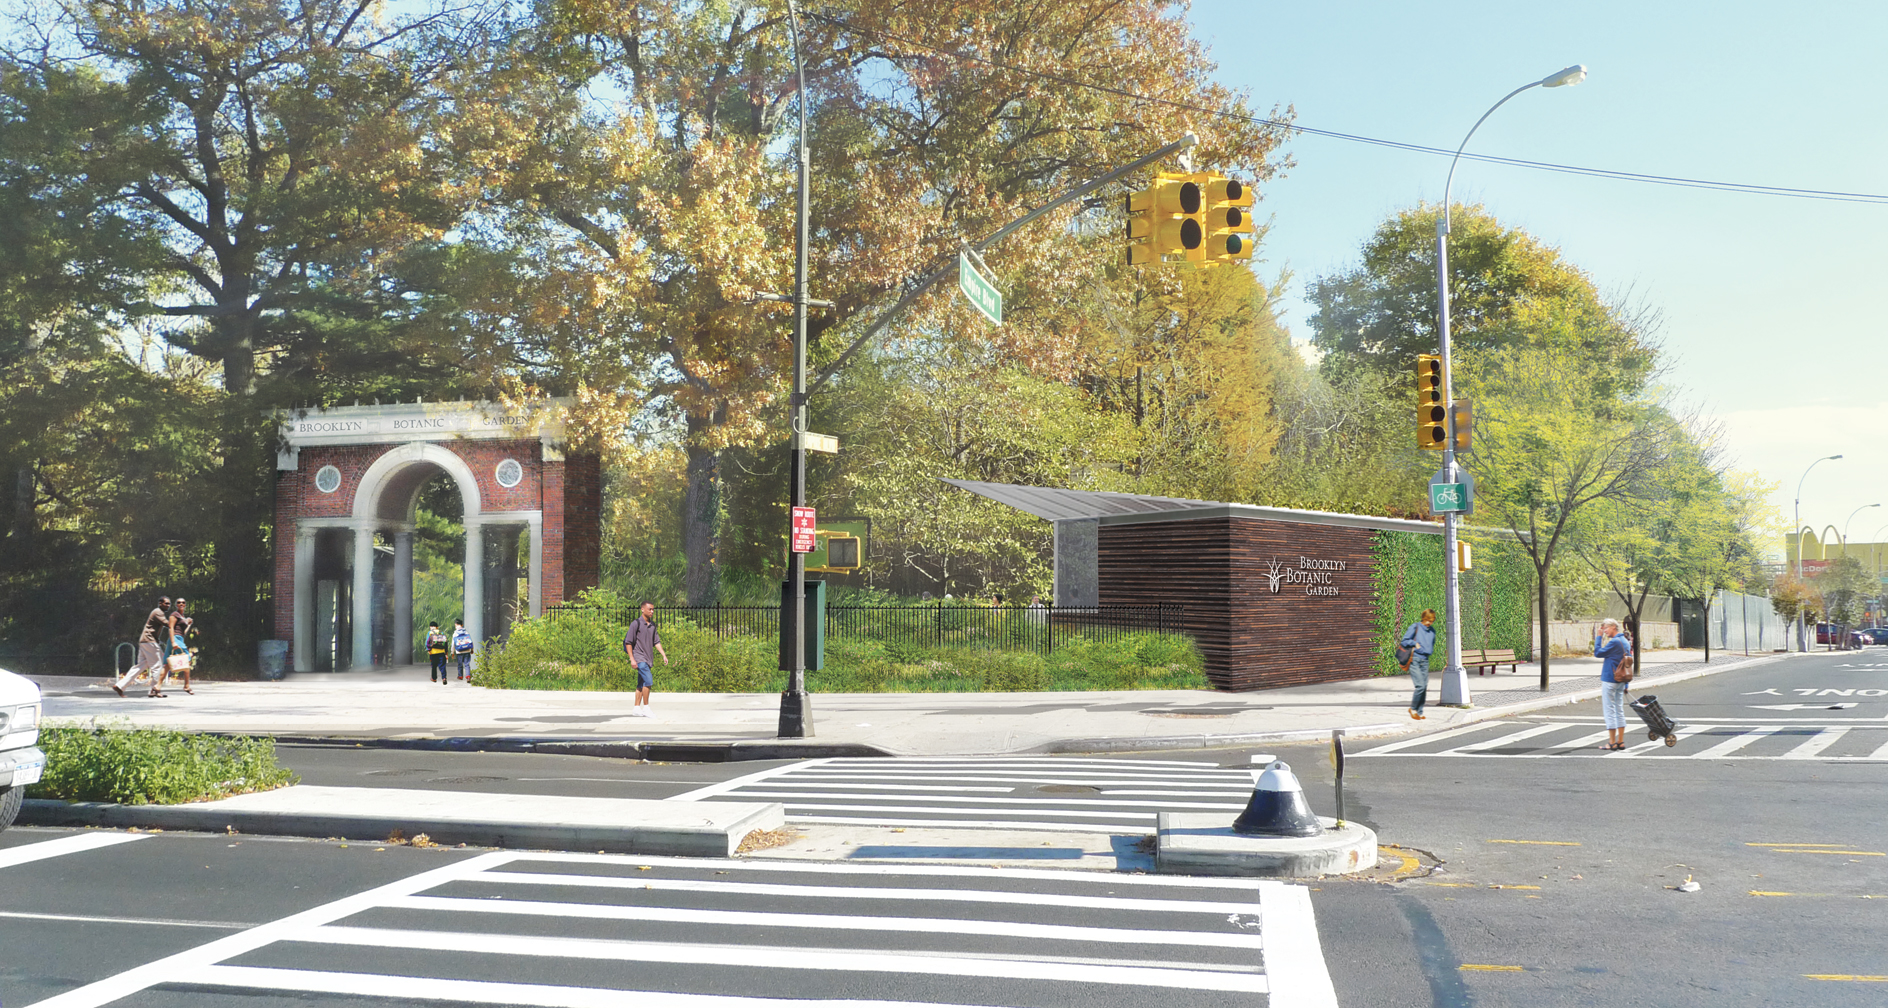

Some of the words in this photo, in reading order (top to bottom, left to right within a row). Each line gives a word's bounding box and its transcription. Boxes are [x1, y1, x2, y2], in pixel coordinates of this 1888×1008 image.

[965, 267, 981, 300] Empire
[983, 288, 995, 313] Blvd
[299, 421, 362, 433] BROOKLYN
[393, 418, 445, 429] BOTANIC
[482, 415, 530, 426] GARDEN
[1300, 556, 1346, 570] BROOKLYN
[1286, 567, 1332, 584] BOTANIC
[1305, 583, 1339, 596] GARDEN
